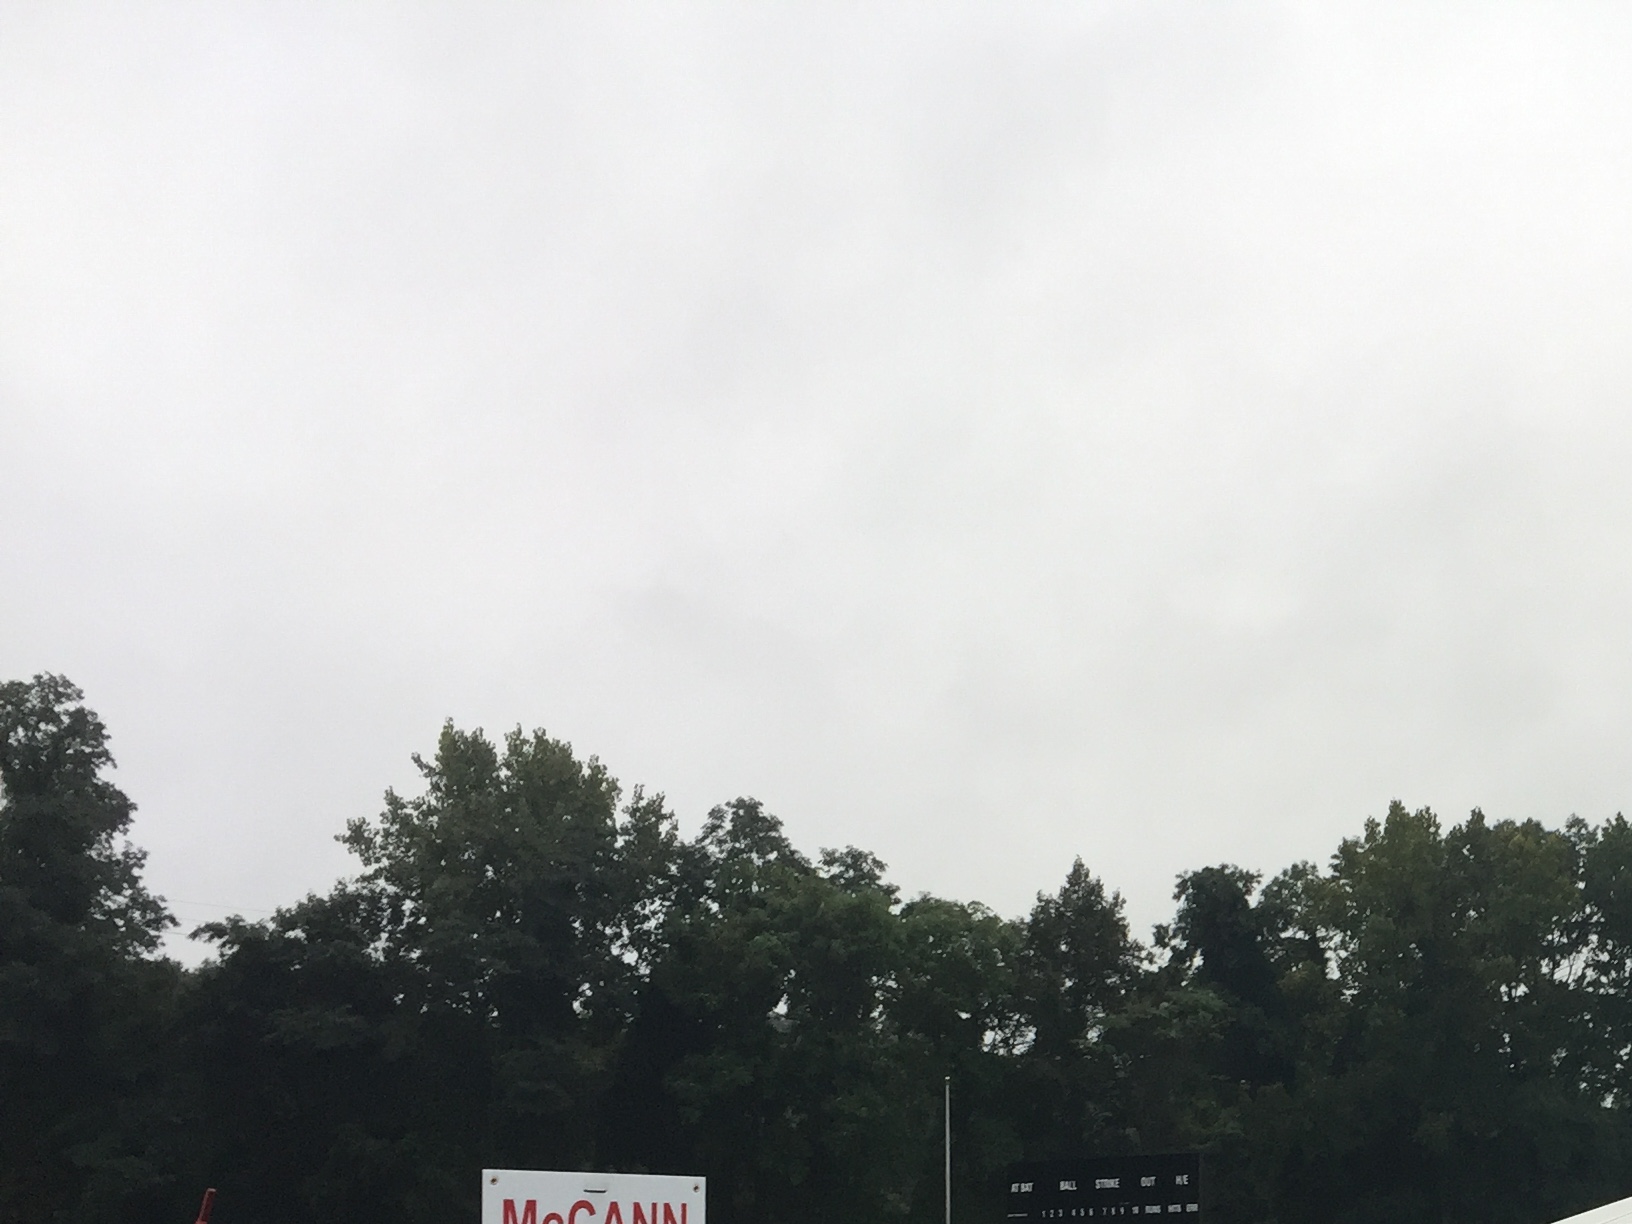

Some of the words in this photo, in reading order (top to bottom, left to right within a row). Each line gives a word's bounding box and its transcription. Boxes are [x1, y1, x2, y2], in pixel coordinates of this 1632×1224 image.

[1059, 1180, 1077, 1191] BALL
[1095, 1178, 1120, 1190] STRIKE
[1140, 1176, 1156, 1187] OUT
